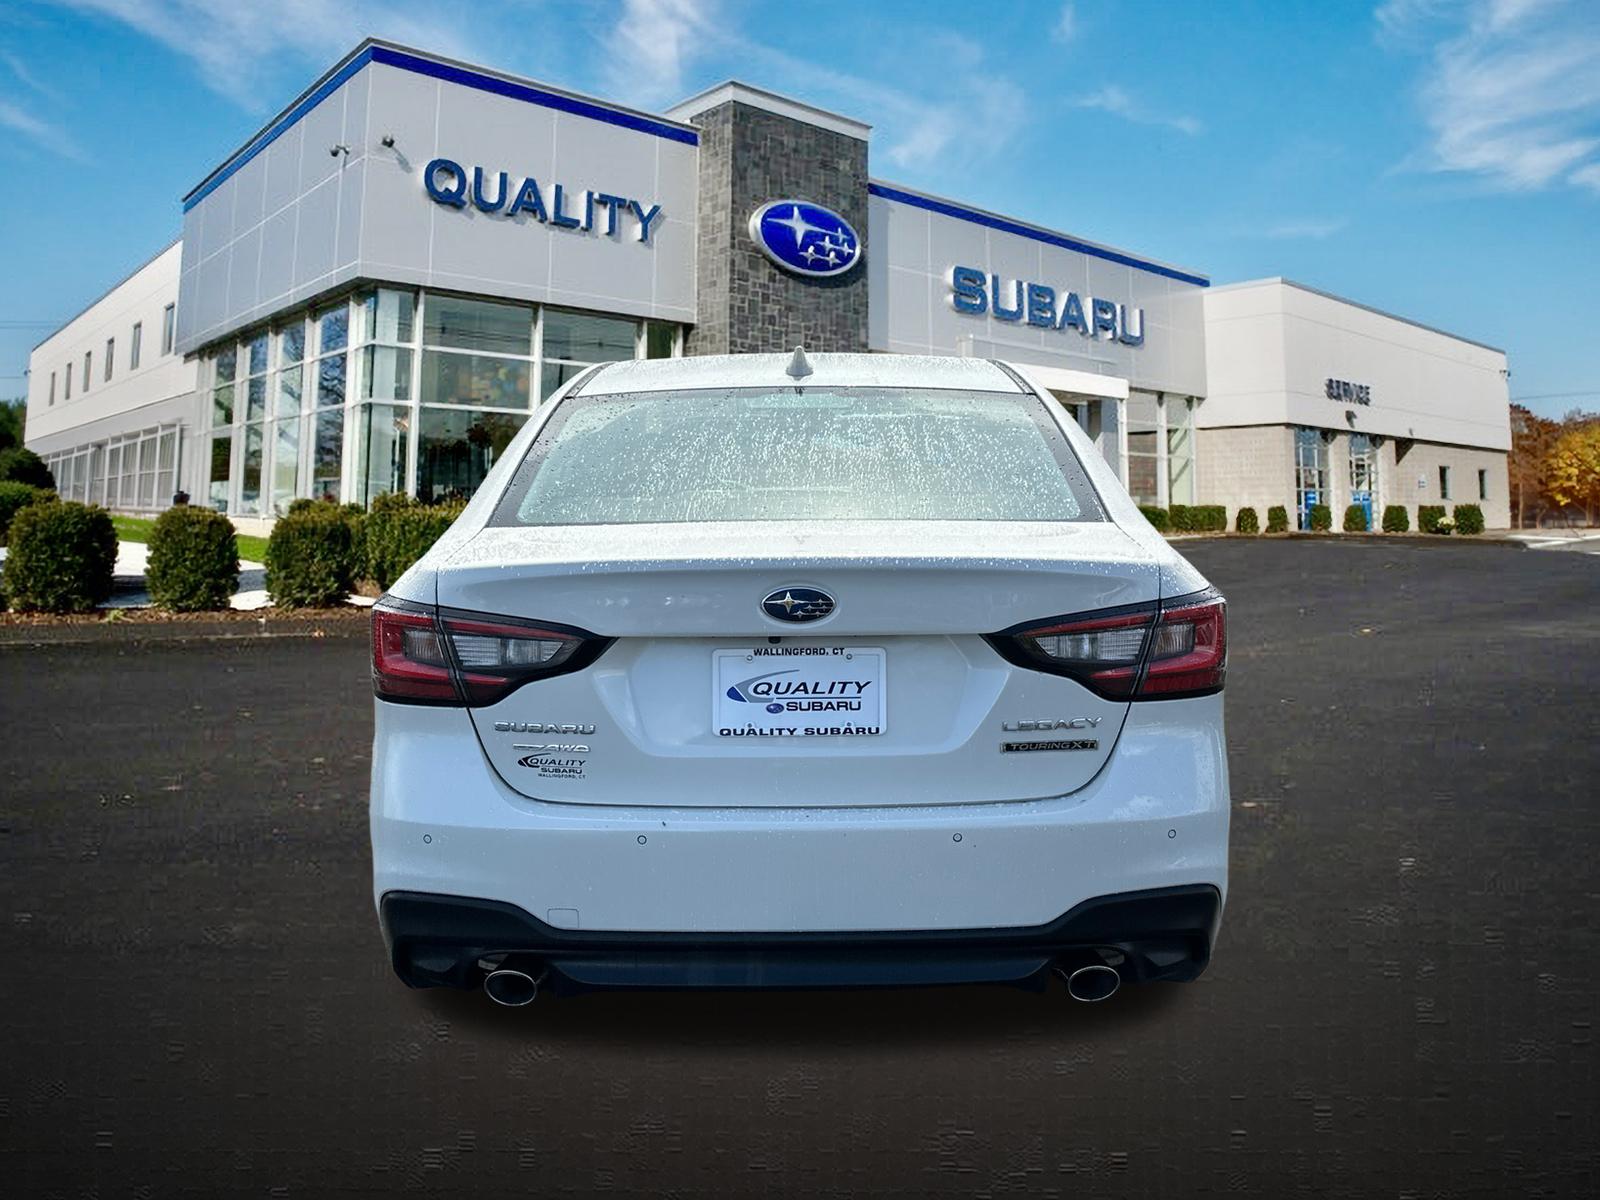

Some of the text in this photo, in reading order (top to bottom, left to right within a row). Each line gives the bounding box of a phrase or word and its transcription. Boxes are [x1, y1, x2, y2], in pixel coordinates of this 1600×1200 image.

[424, 158, 662, 243] QUALITY
[951, 265, 1145, 347] SUBARU
[1325, 378, 1371, 406] SERVICE
[832, 647, 845, 656] CT
[752, 681, 873, 695] QUALITY
[786, 701, 862, 711] SUBARU
[494, 721, 596, 735] SUBARU
[719, 726, 880, 736] QUALITY SUBARU
[1002, 717, 1102, 731] LEGACY
[544, 743, 591, 753] AWD
[529, 758, 586, 766] QUALITY
